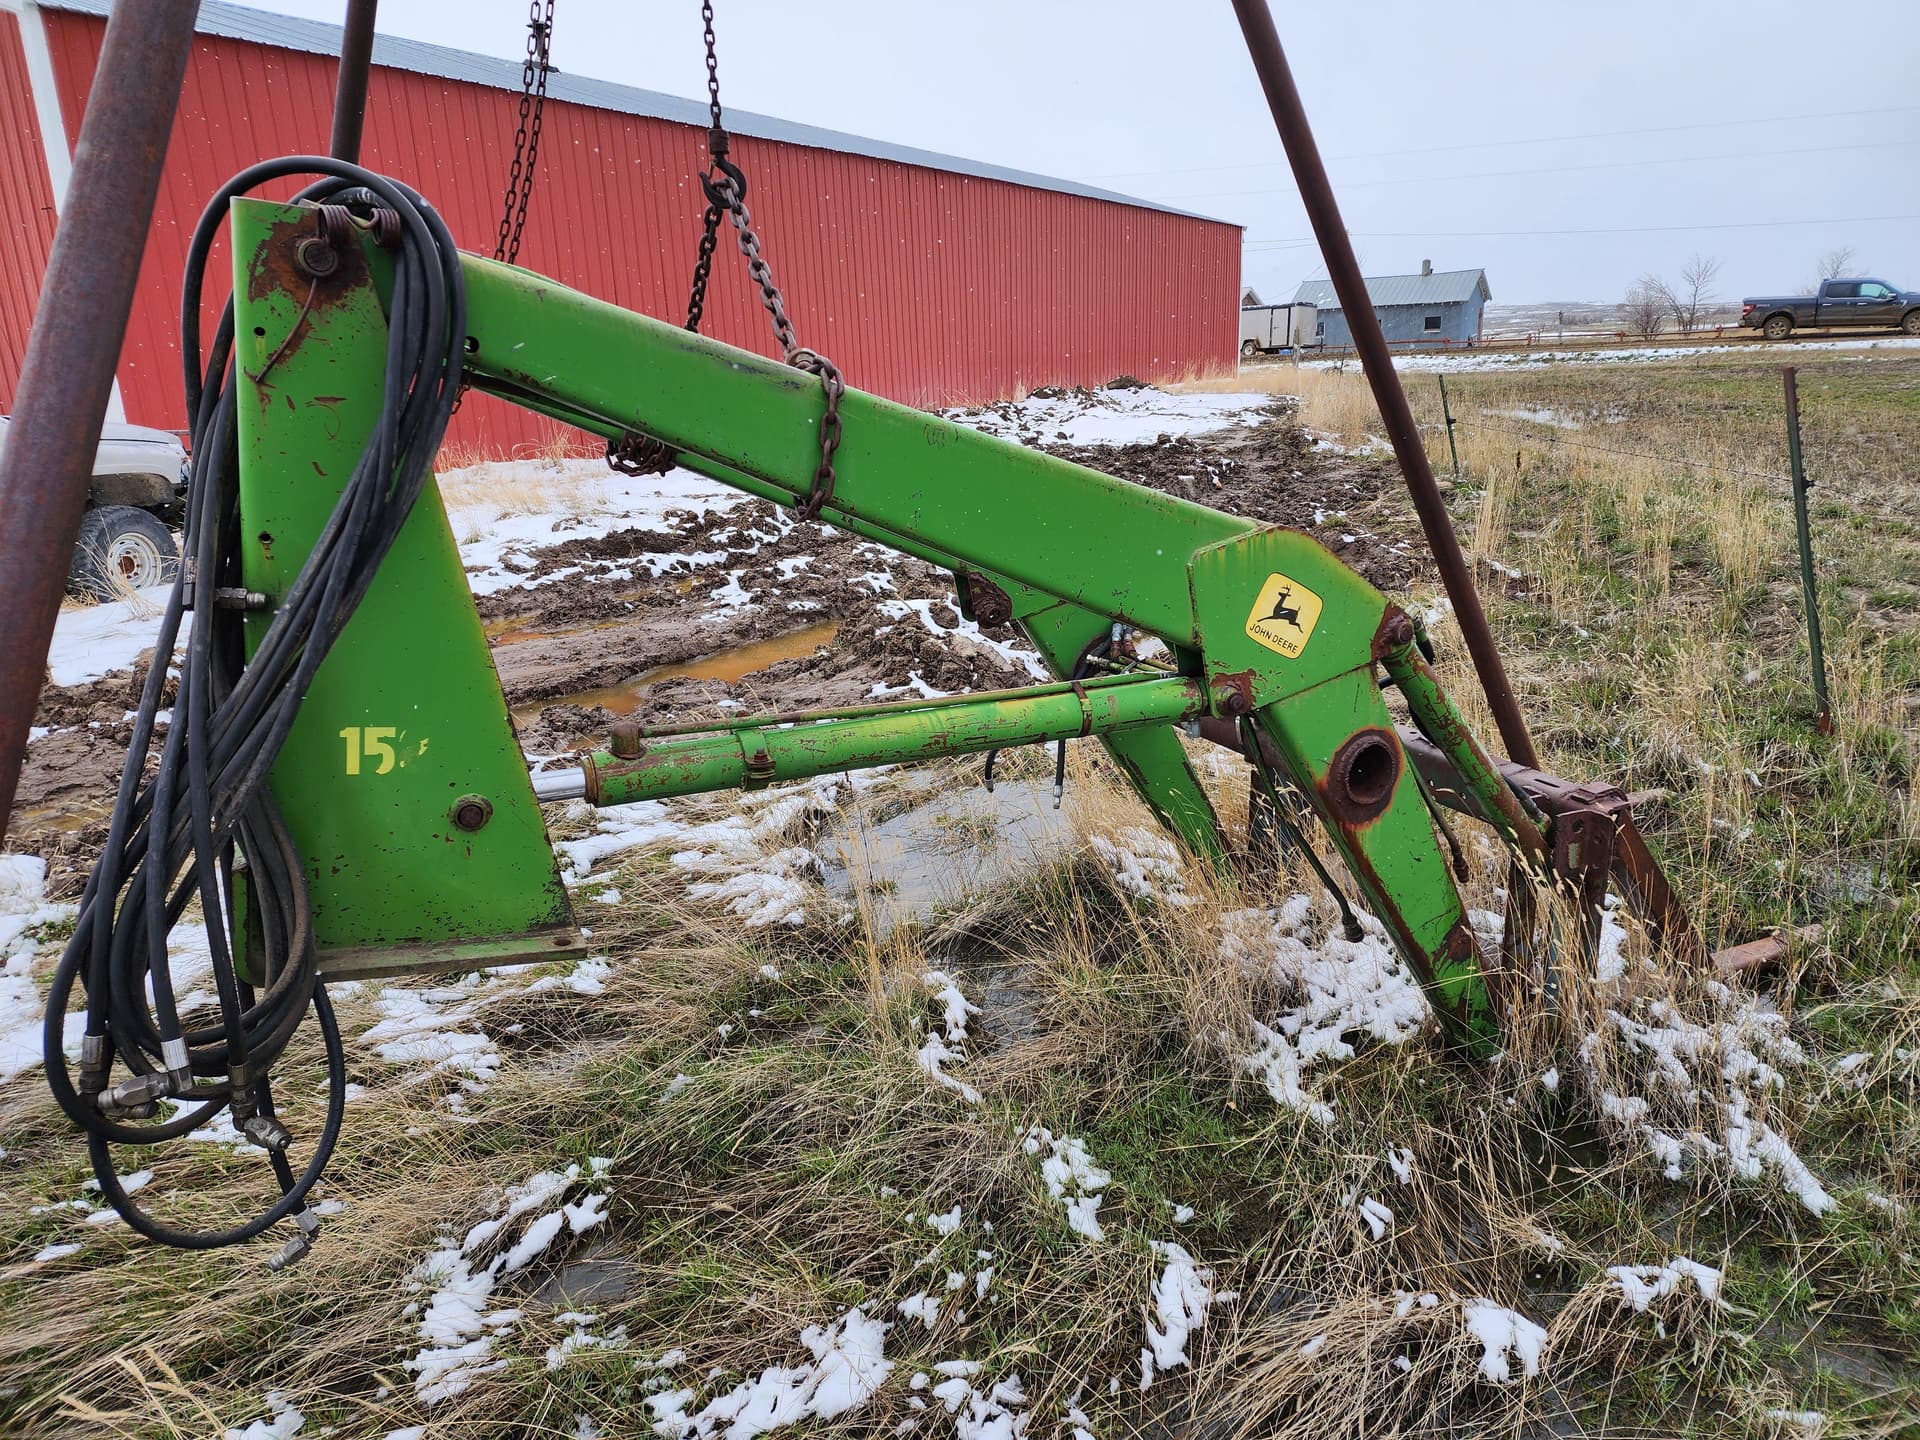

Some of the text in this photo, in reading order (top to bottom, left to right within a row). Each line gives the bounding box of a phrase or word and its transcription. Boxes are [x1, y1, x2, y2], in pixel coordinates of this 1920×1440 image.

[1249, 623, 1298, 654] JOHN DEERE
[339, 727, 428, 775] 15
